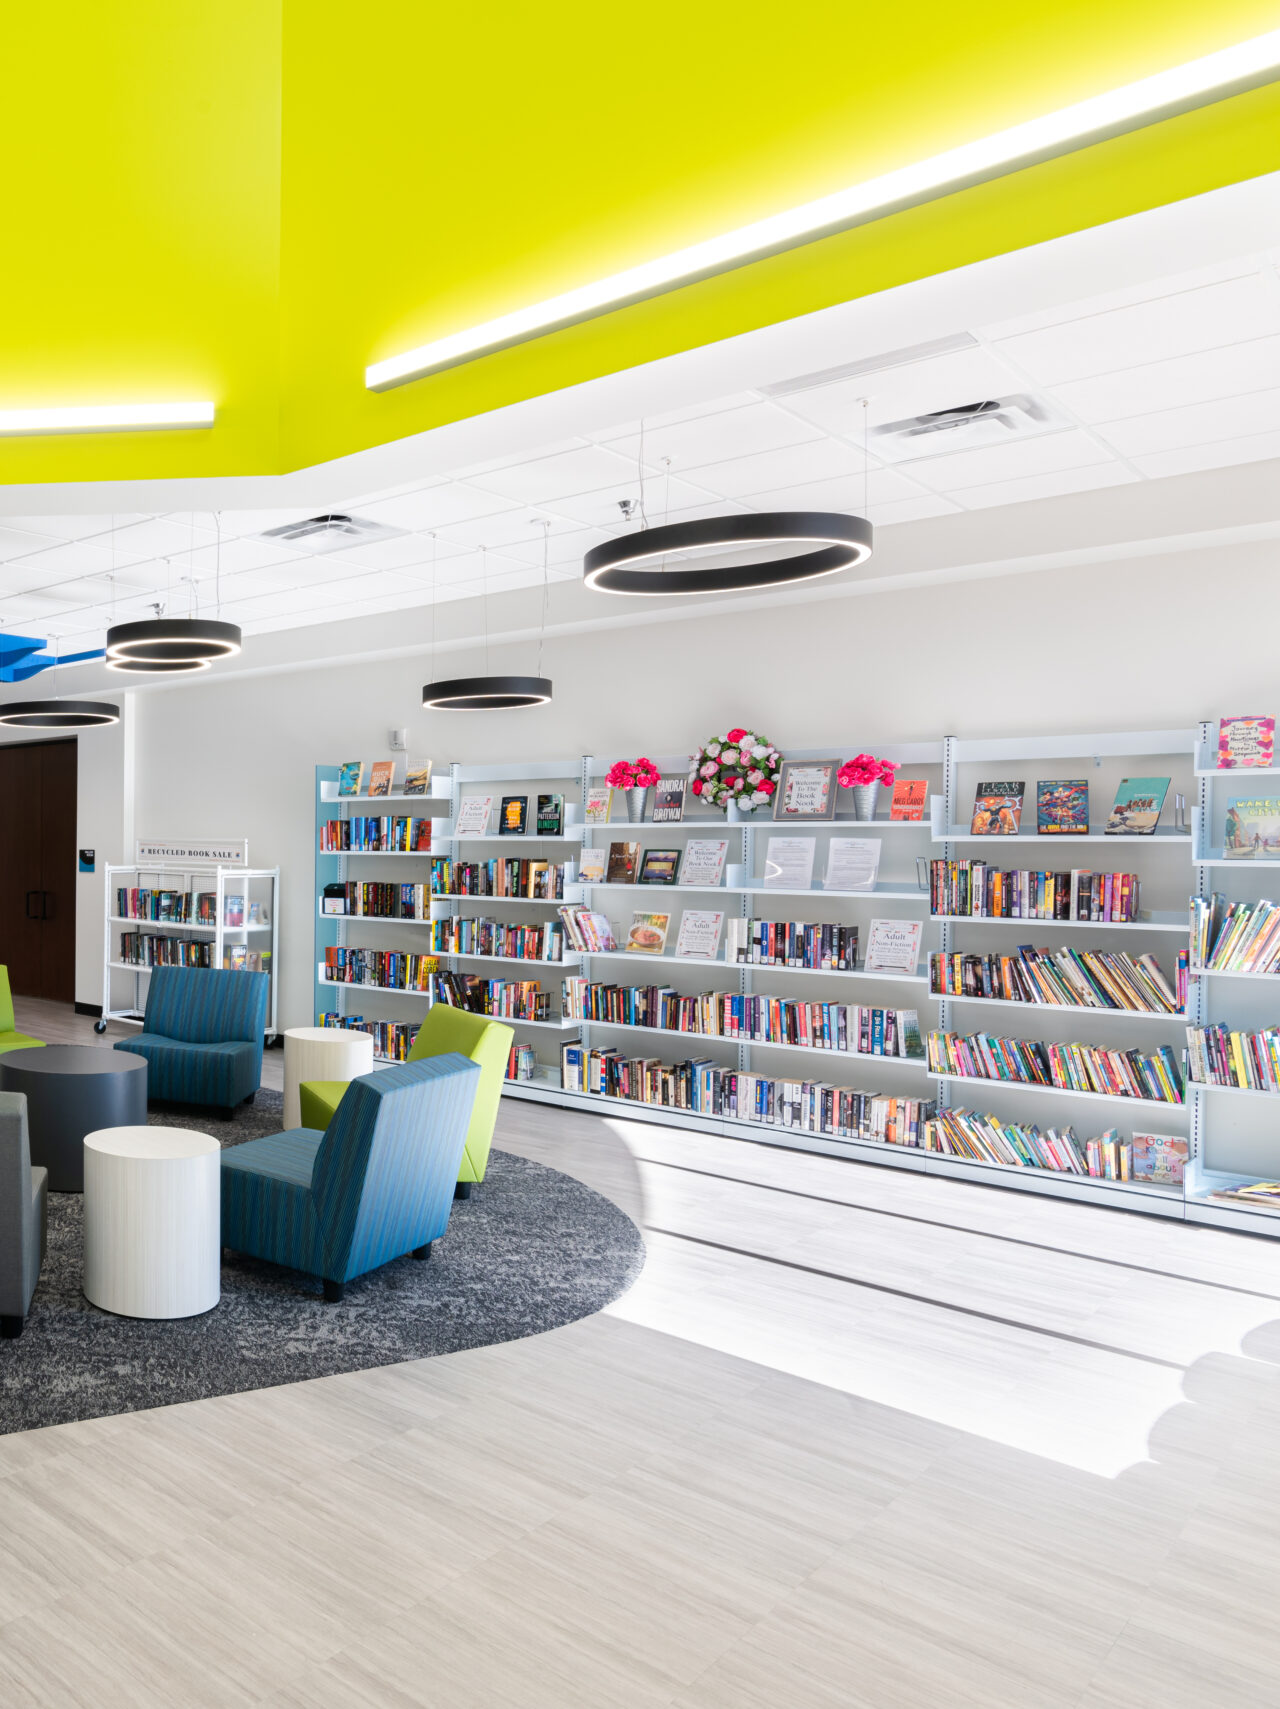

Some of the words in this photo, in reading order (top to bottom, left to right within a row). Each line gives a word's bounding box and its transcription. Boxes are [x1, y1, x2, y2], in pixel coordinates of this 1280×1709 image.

[657, 779, 683, 792] SANDRA
[653, 808, 681, 820] BROWN
[1146, 1136, 1174, 1147] God
[1146, 1163, 1177, 1172] about
